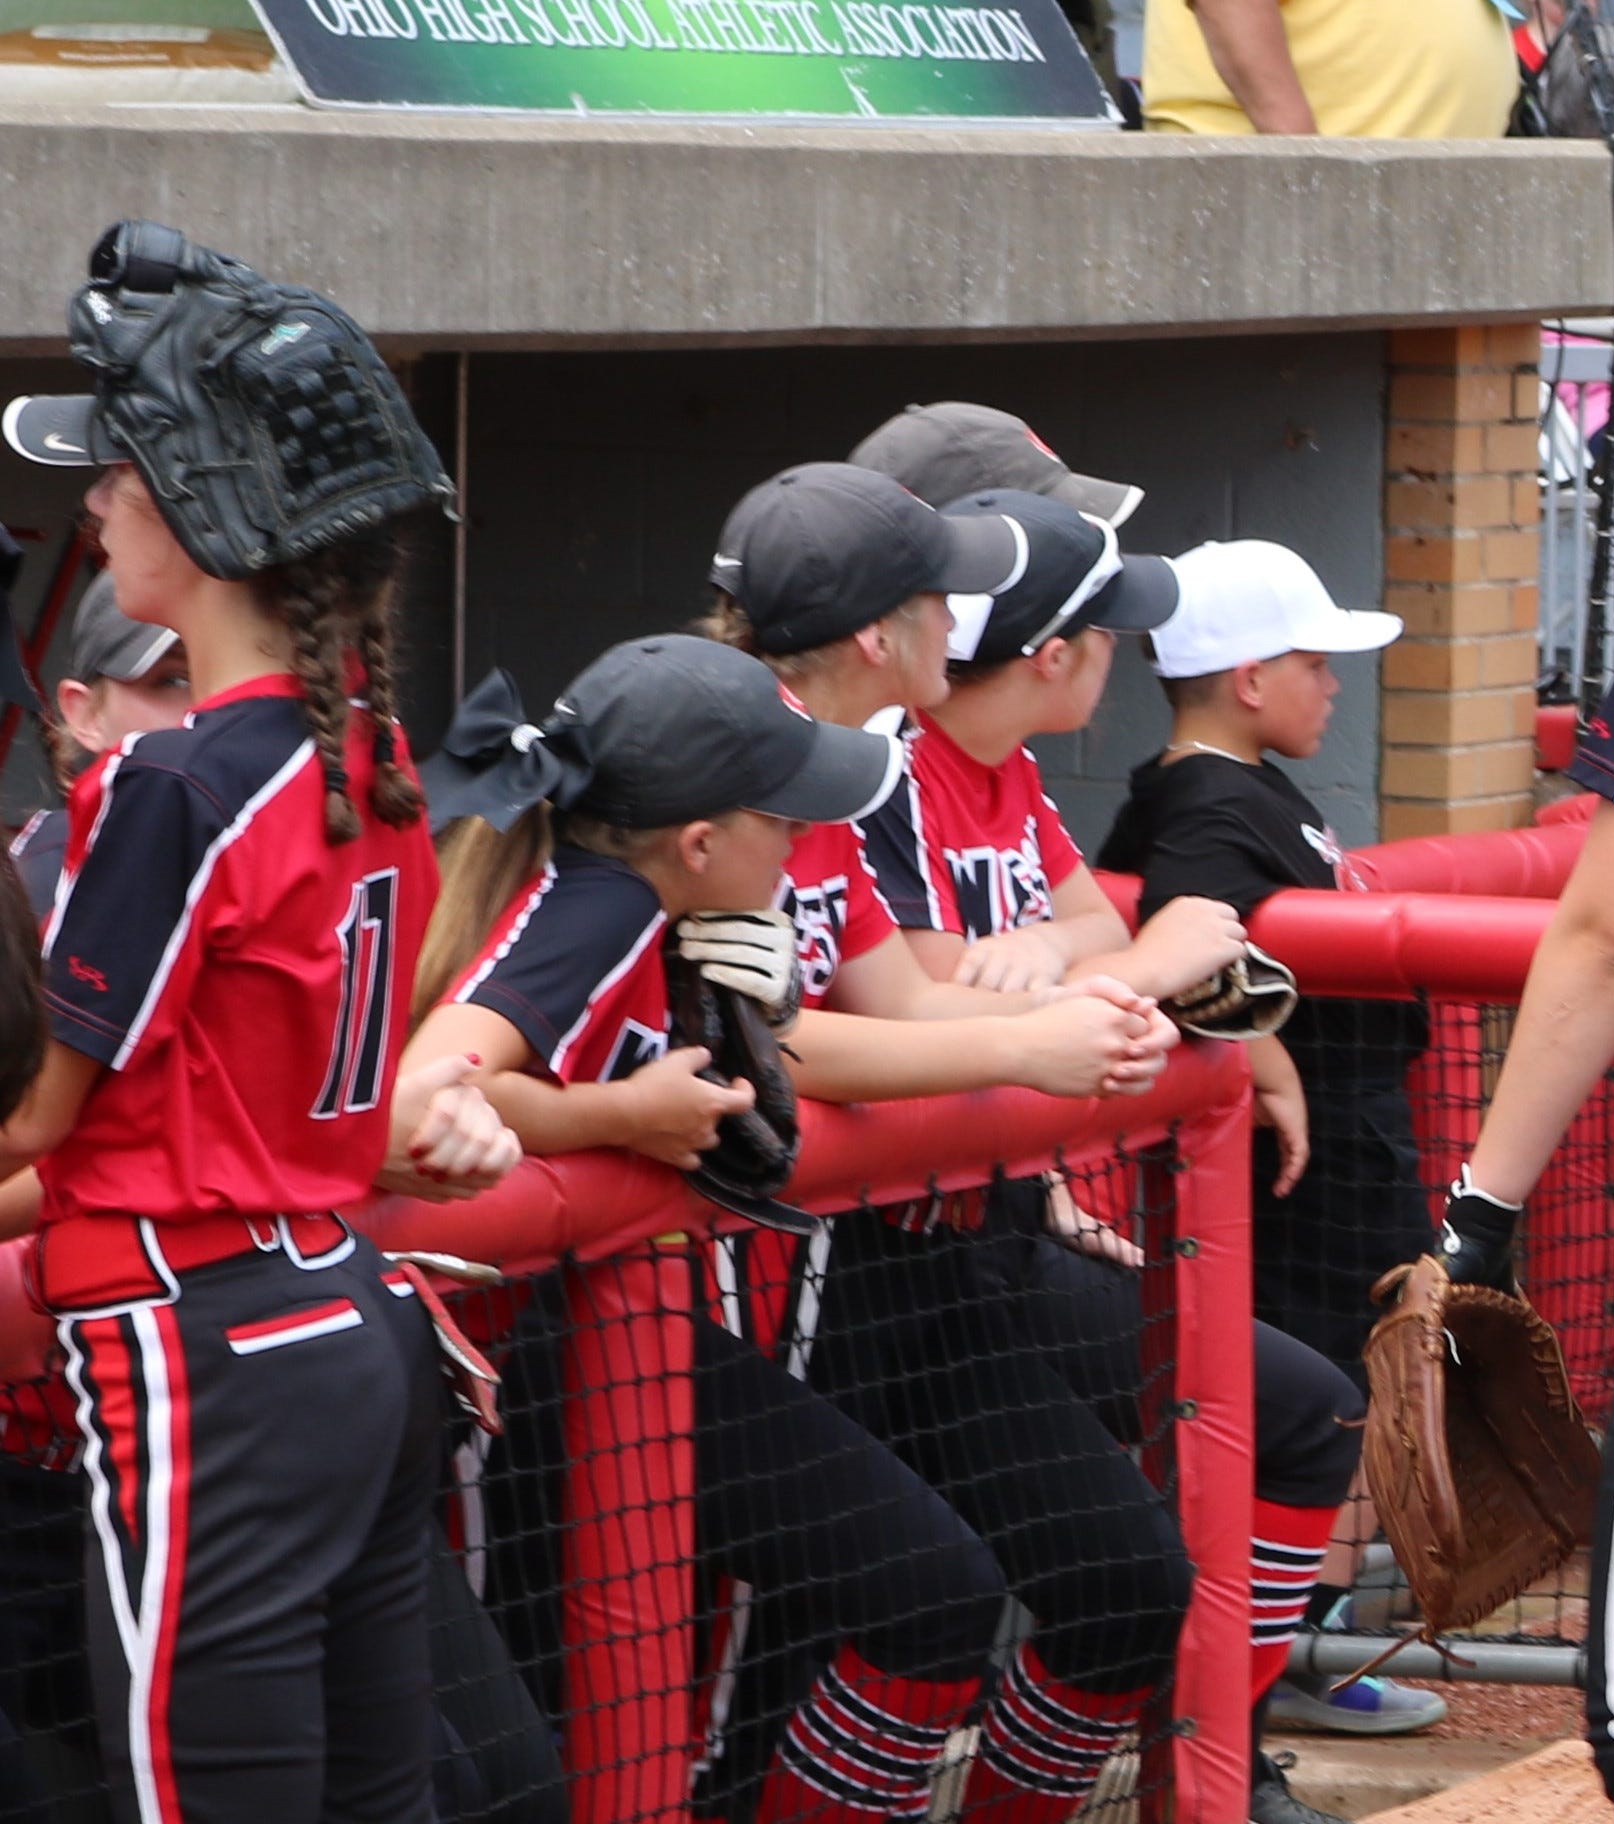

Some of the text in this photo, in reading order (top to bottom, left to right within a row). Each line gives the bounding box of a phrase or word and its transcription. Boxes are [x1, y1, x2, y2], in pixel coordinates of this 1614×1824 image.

[308, 0, 1047, 63] OHIO HIGH SCHOOL ATHLETIC ASSOCIATION
[308, 866, 399, 1120] 11
